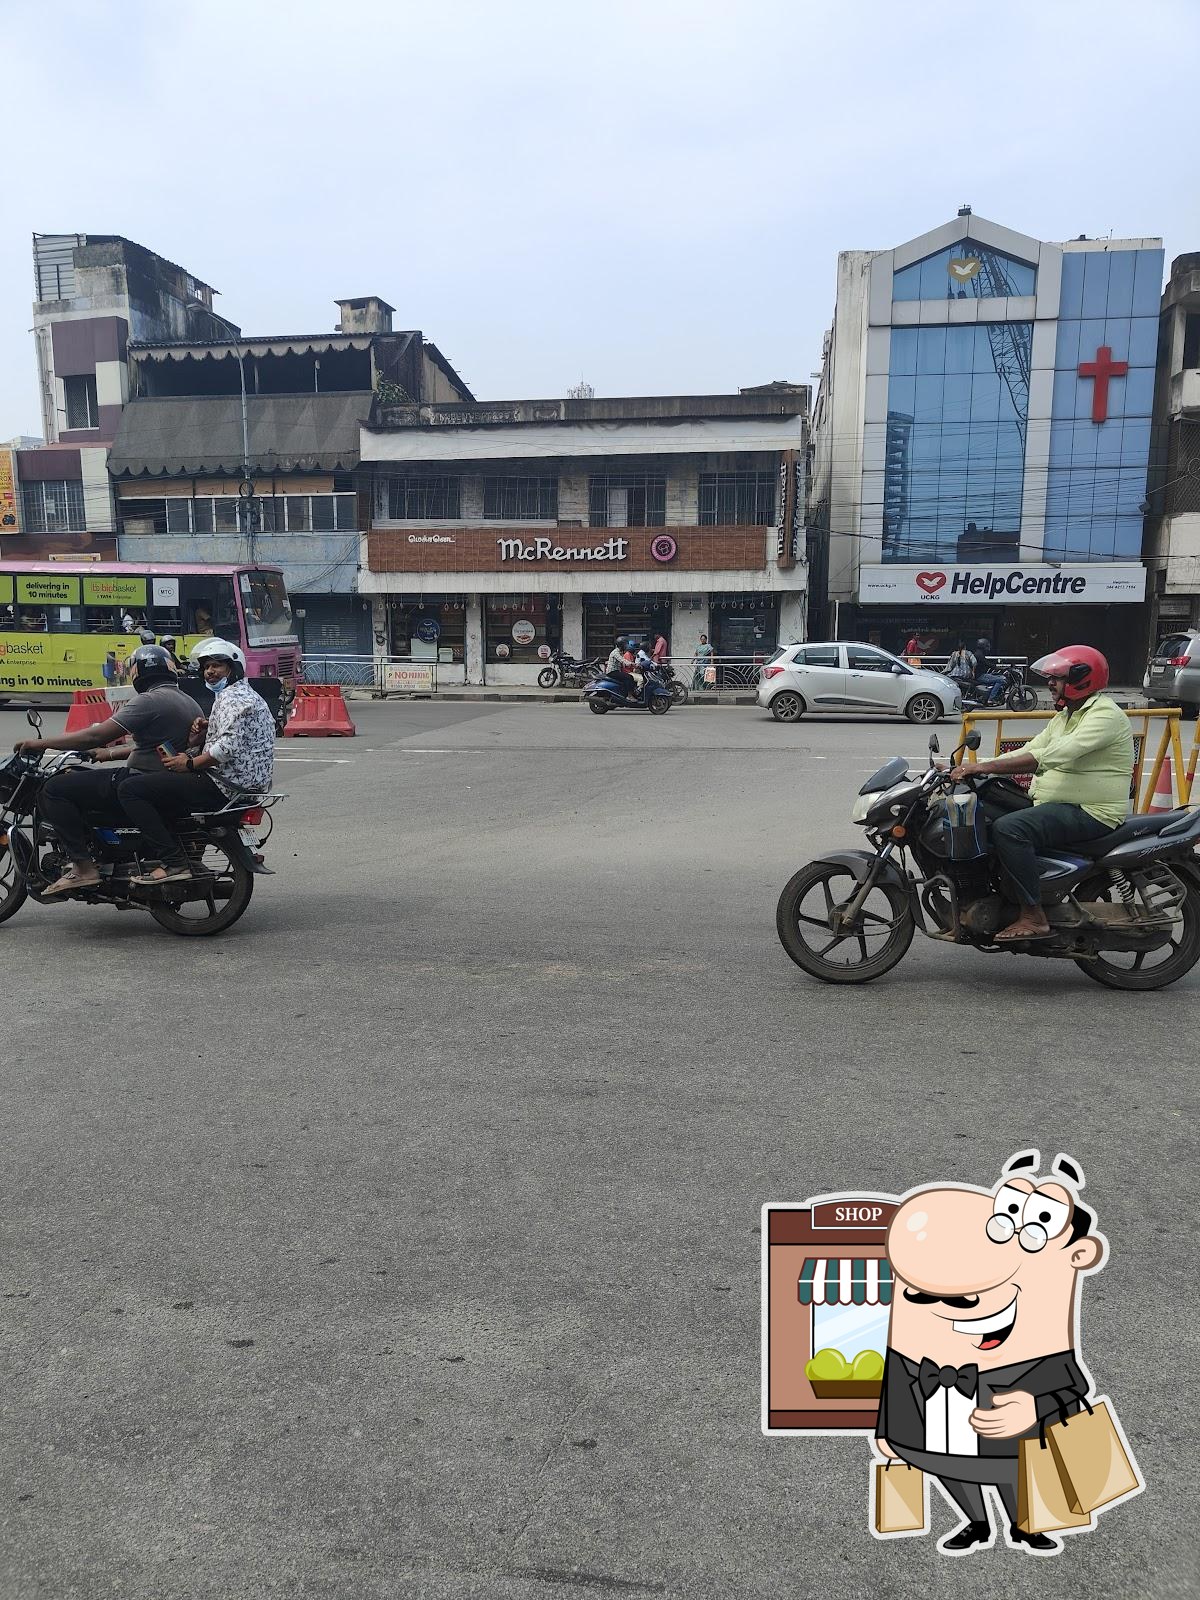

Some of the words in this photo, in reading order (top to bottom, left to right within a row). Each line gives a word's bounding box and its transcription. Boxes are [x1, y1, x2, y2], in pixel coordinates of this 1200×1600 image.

[497, 537, 629, 561] McRennett
[26, 582, 61, 592] delivering
[62, 582, 70, 591] in
[951, 571, 1087, 600] HelpCentre
[28, 591, 38, 599] 10
[39, 591, 68, 599] minutes
[394, 671, 408, 679] NO
[18, 675, 29, 685] in
[31, 676, 44, 685] 10
[47, 676, 93, 687] minutes
